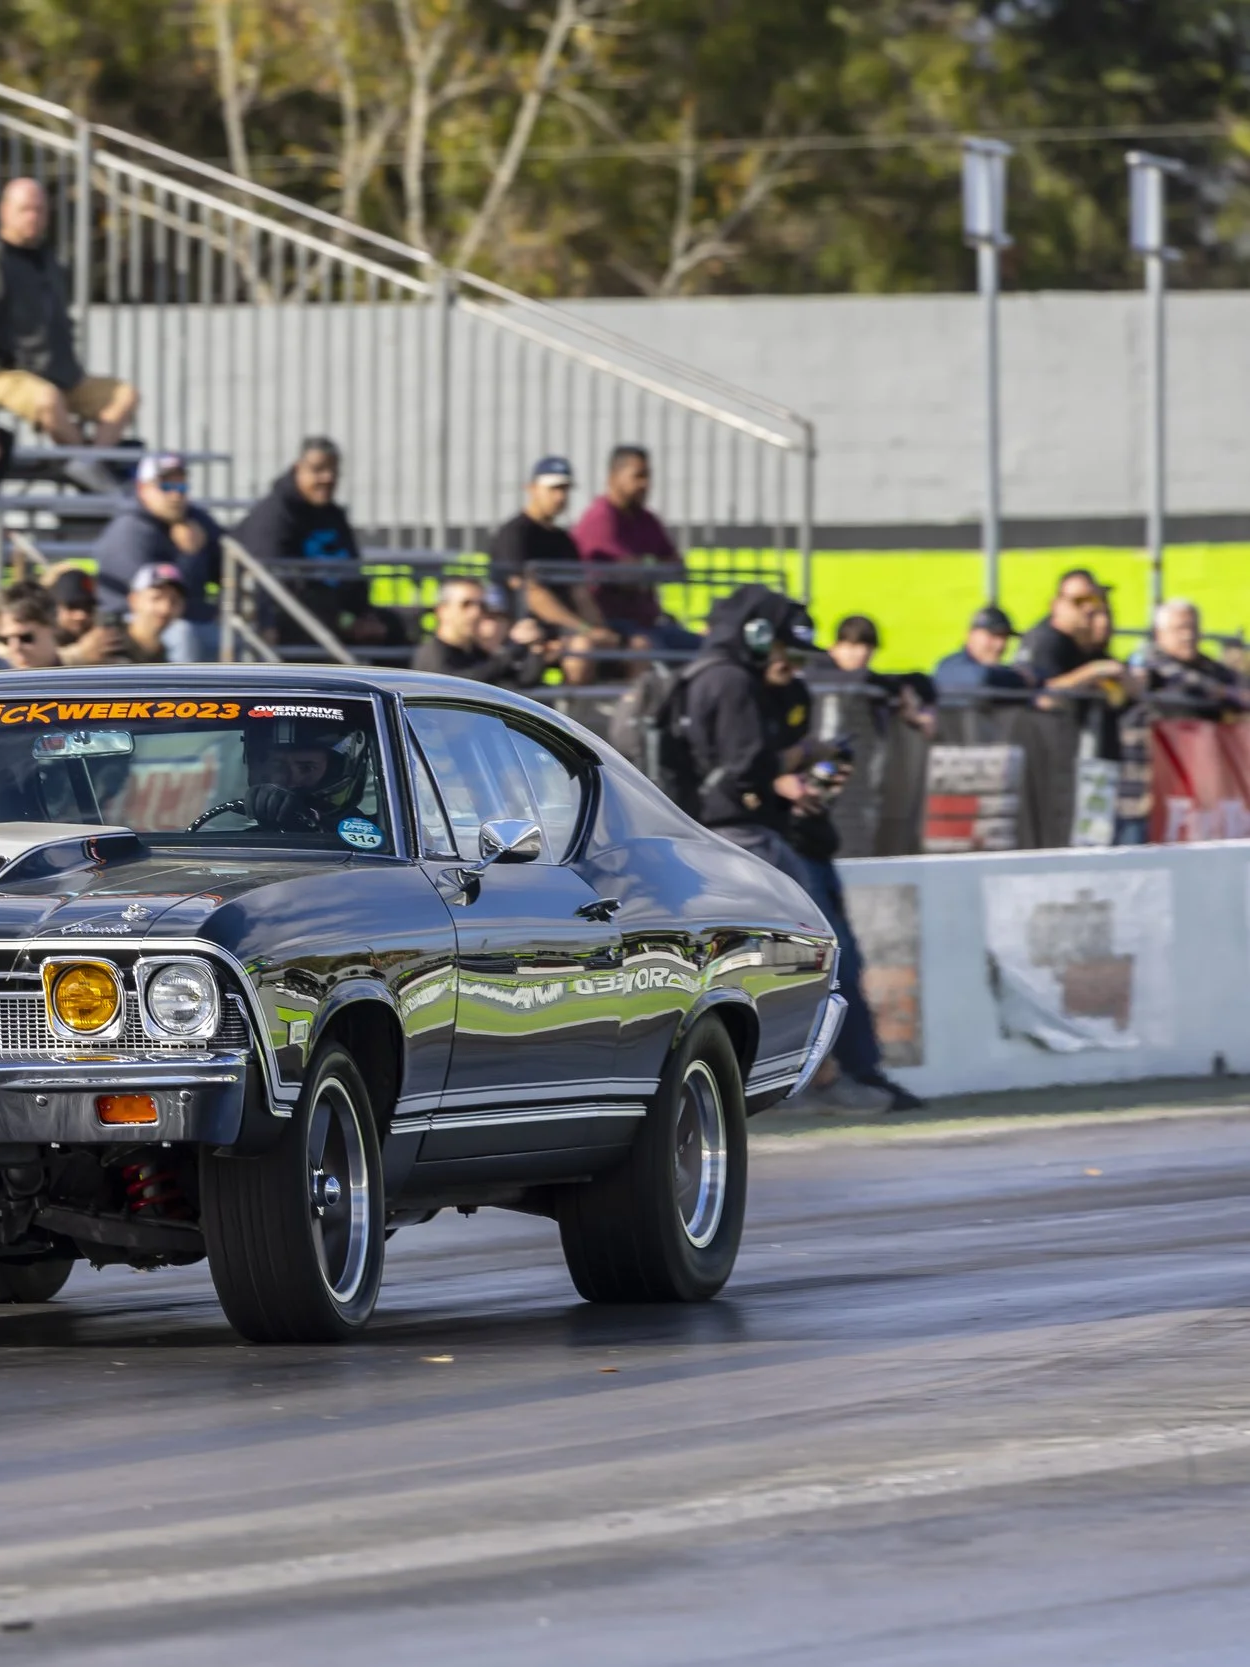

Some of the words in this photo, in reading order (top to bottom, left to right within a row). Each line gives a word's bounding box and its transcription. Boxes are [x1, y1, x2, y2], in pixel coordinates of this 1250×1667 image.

[57, 702, 154, 720] WEEK
[154, 702, 242, 719] 2023
[253, 705, 344, 716] OVERDRIVE
[300, 711, 344, 721] VENDORS
[348, 833, 377, 844] 314
